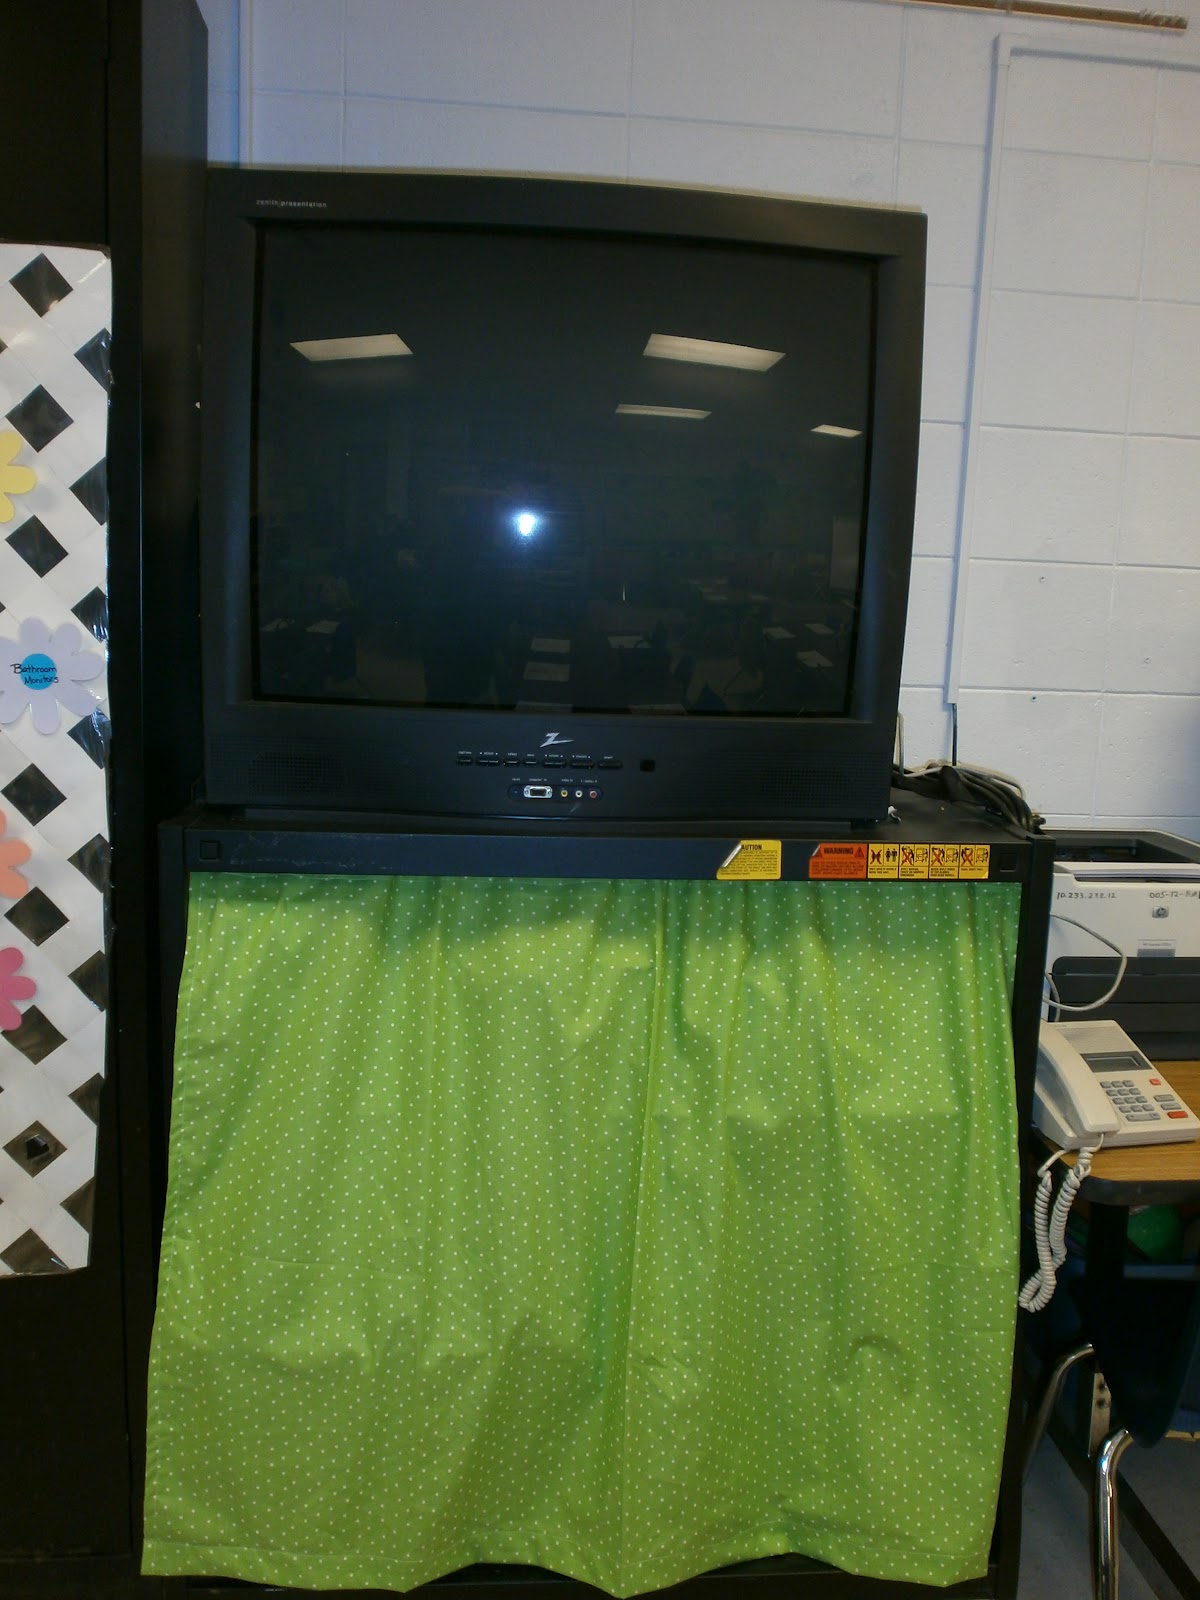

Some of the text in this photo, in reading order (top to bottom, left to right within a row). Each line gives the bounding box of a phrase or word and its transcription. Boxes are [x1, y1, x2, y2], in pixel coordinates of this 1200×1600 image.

[280, 200, 327, 208] presentation
[10, 663, 57, 675] Bathroom
[24, 675, 59, 685] Monitors
[823, 847, 854, 855] WARNING
